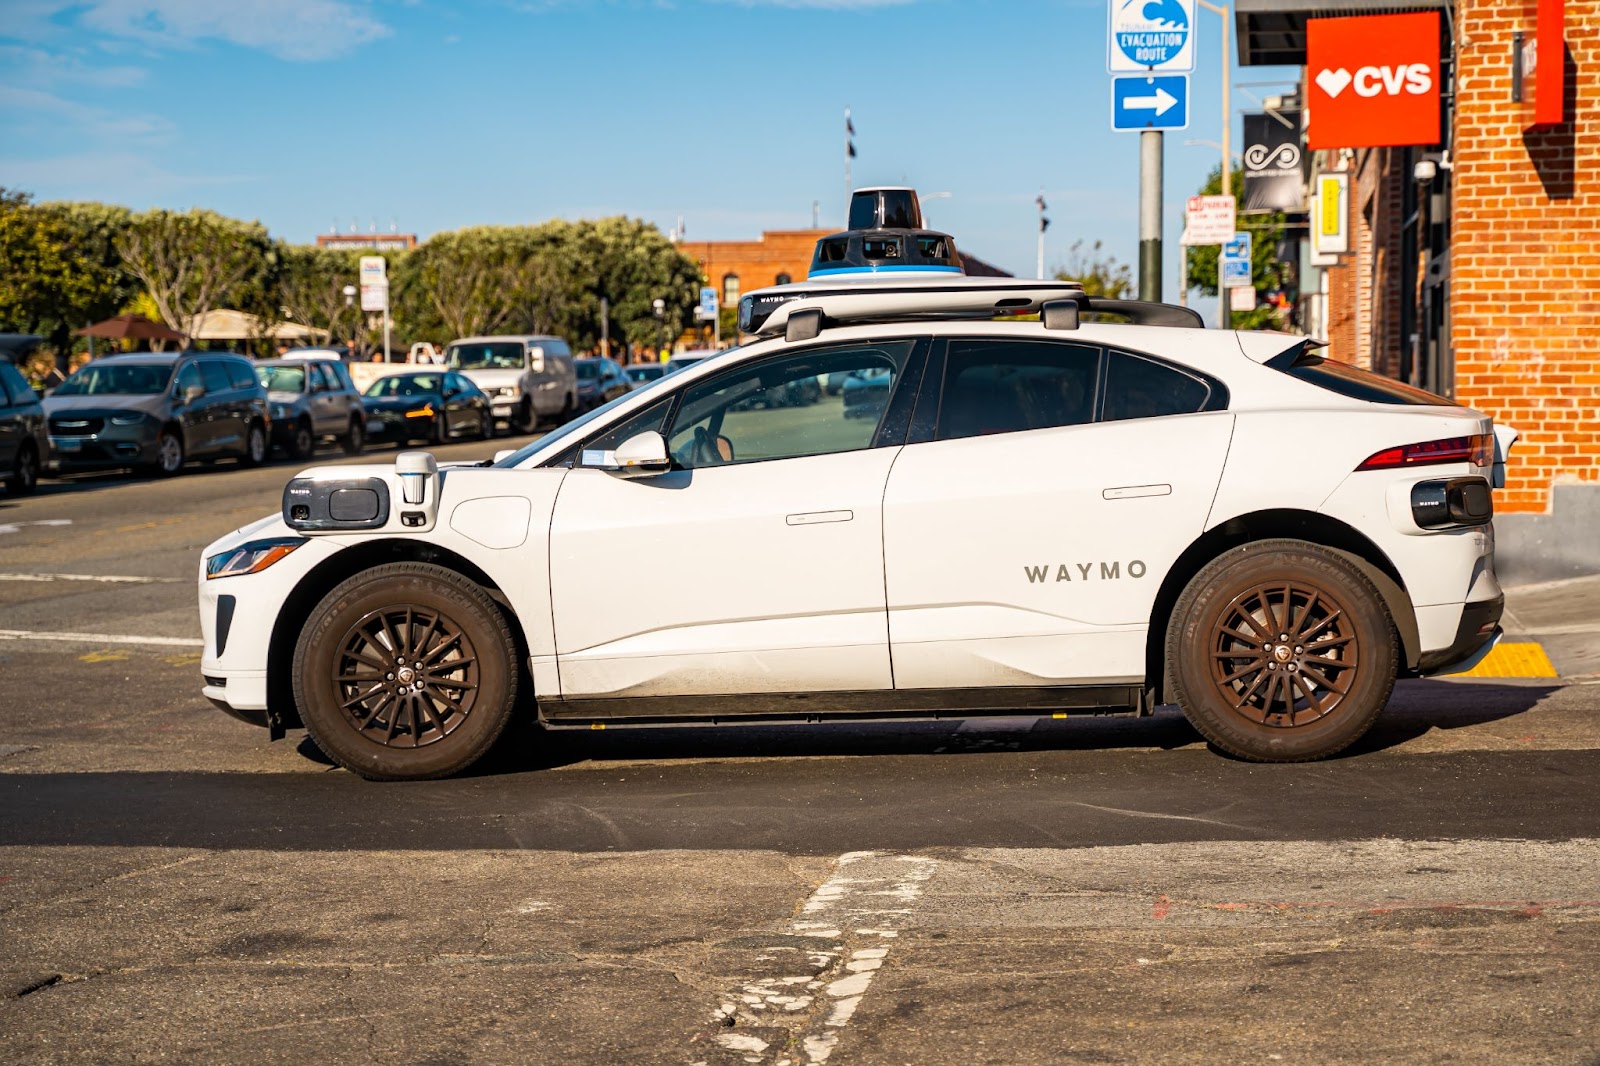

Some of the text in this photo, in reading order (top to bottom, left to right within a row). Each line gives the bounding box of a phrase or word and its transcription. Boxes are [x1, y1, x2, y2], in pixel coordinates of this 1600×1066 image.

[1121, 33, 1183, 47] EVACUATION
[1135, 47, 1167, 61] ROUTE
[1353, 63, 1432, 97] CVS
[1024, 560, 1147, 584] WAYMO
